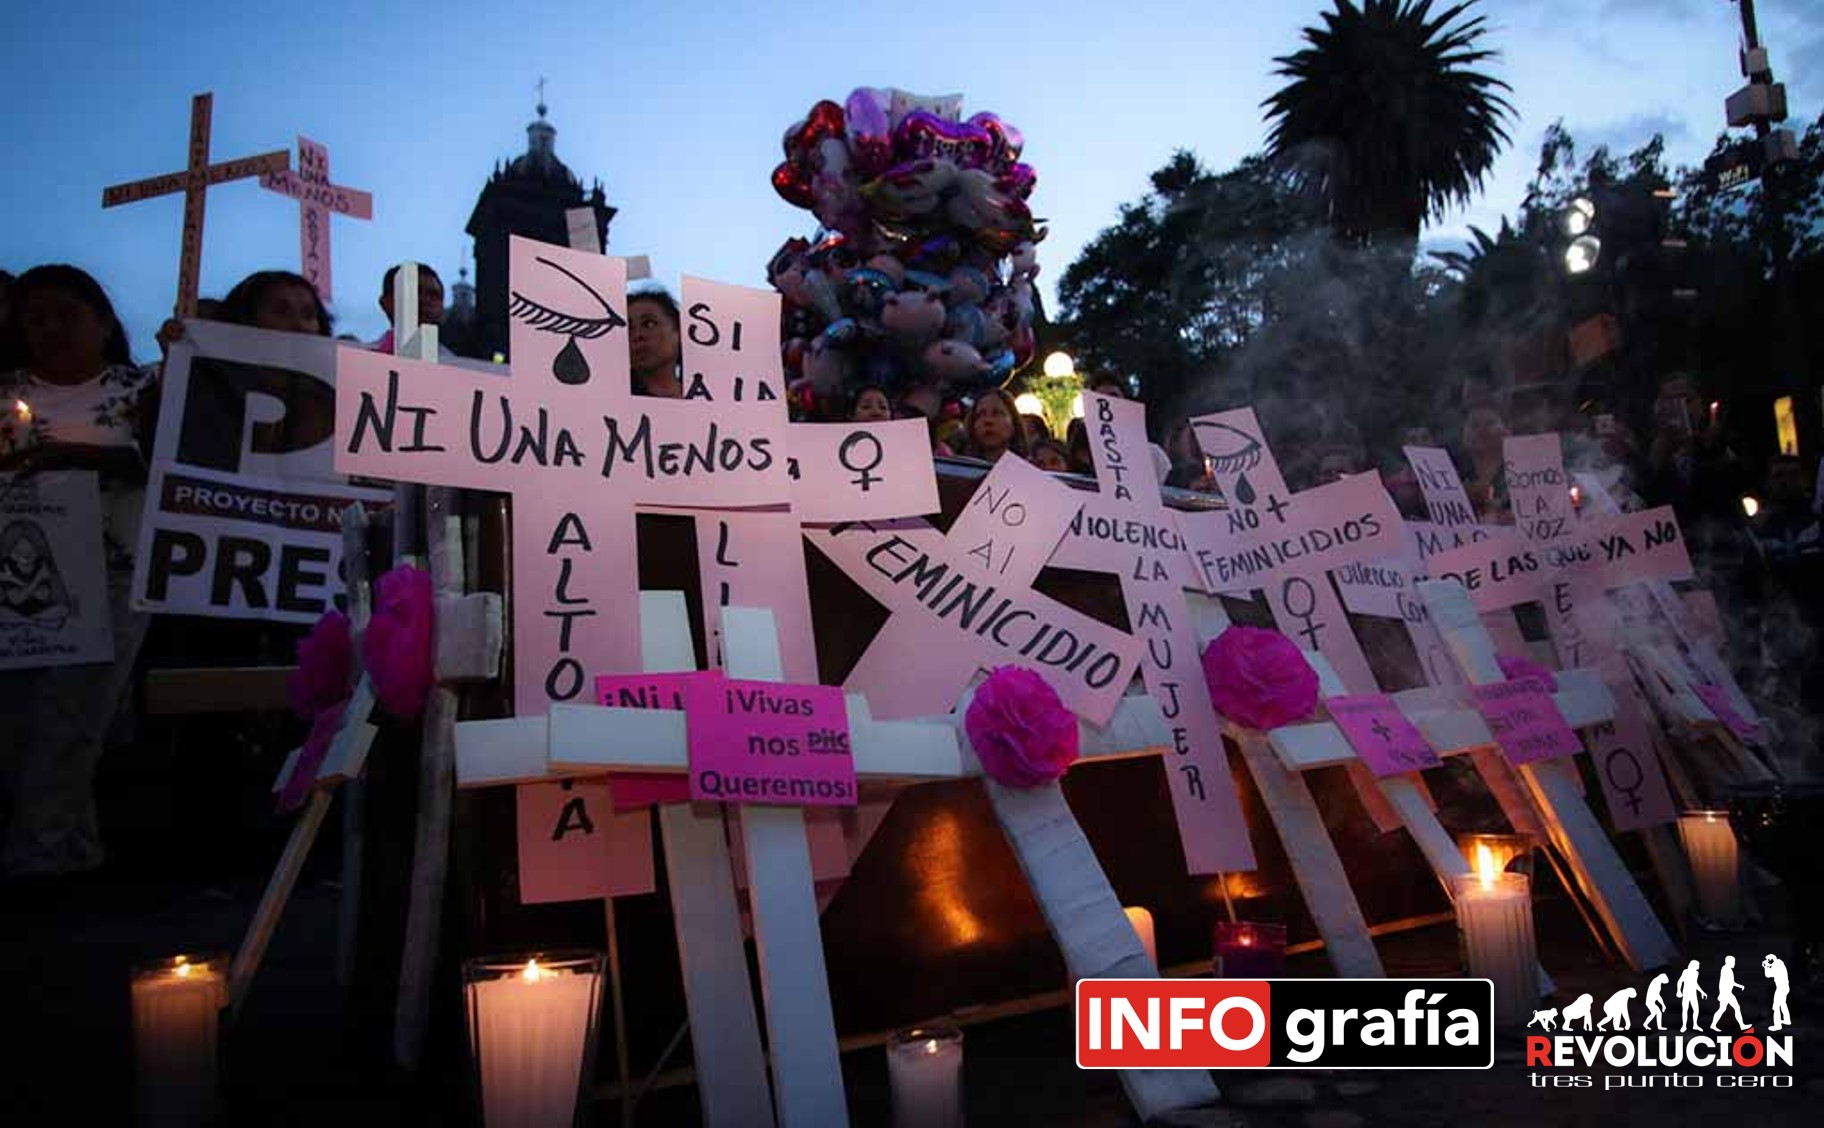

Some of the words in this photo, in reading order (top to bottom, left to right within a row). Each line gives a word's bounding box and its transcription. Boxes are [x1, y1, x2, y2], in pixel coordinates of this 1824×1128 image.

[299, 146, 327, 170] NI
[688, 304, 742, 352] SI
[348, 370, 445, 455] NI
[470, 390, 586, 467] UNA
[602, 414, 773, 480] MENOS
[1097, 399, 1132, 501] BASTA
[1416, 461, 1460, 491] NI
[173, 485, 320, 523] PROYECTO
[974, 485, 1026, 527] NO
[1227, 508, 1259, 535] NO
[1427, 500, 1474, 528] UNA
[1523, 517, 1573, 541] VOZ
[1133, 555, 1169, 582] LA
[1197, 513, 1381, 591] FEMINICIDIOS
[1491, 550, 1539, 583] LAS
[1600, 534, 1635, 561] YA
[1643, 520, 1677, 549] NO
[543, 511, 597, 701] ALTO
[725, 689, 815, 717] ¡Vivas
[1139, 602, 1205, 800] MUJER
[747, 734, 801, 757] nos
